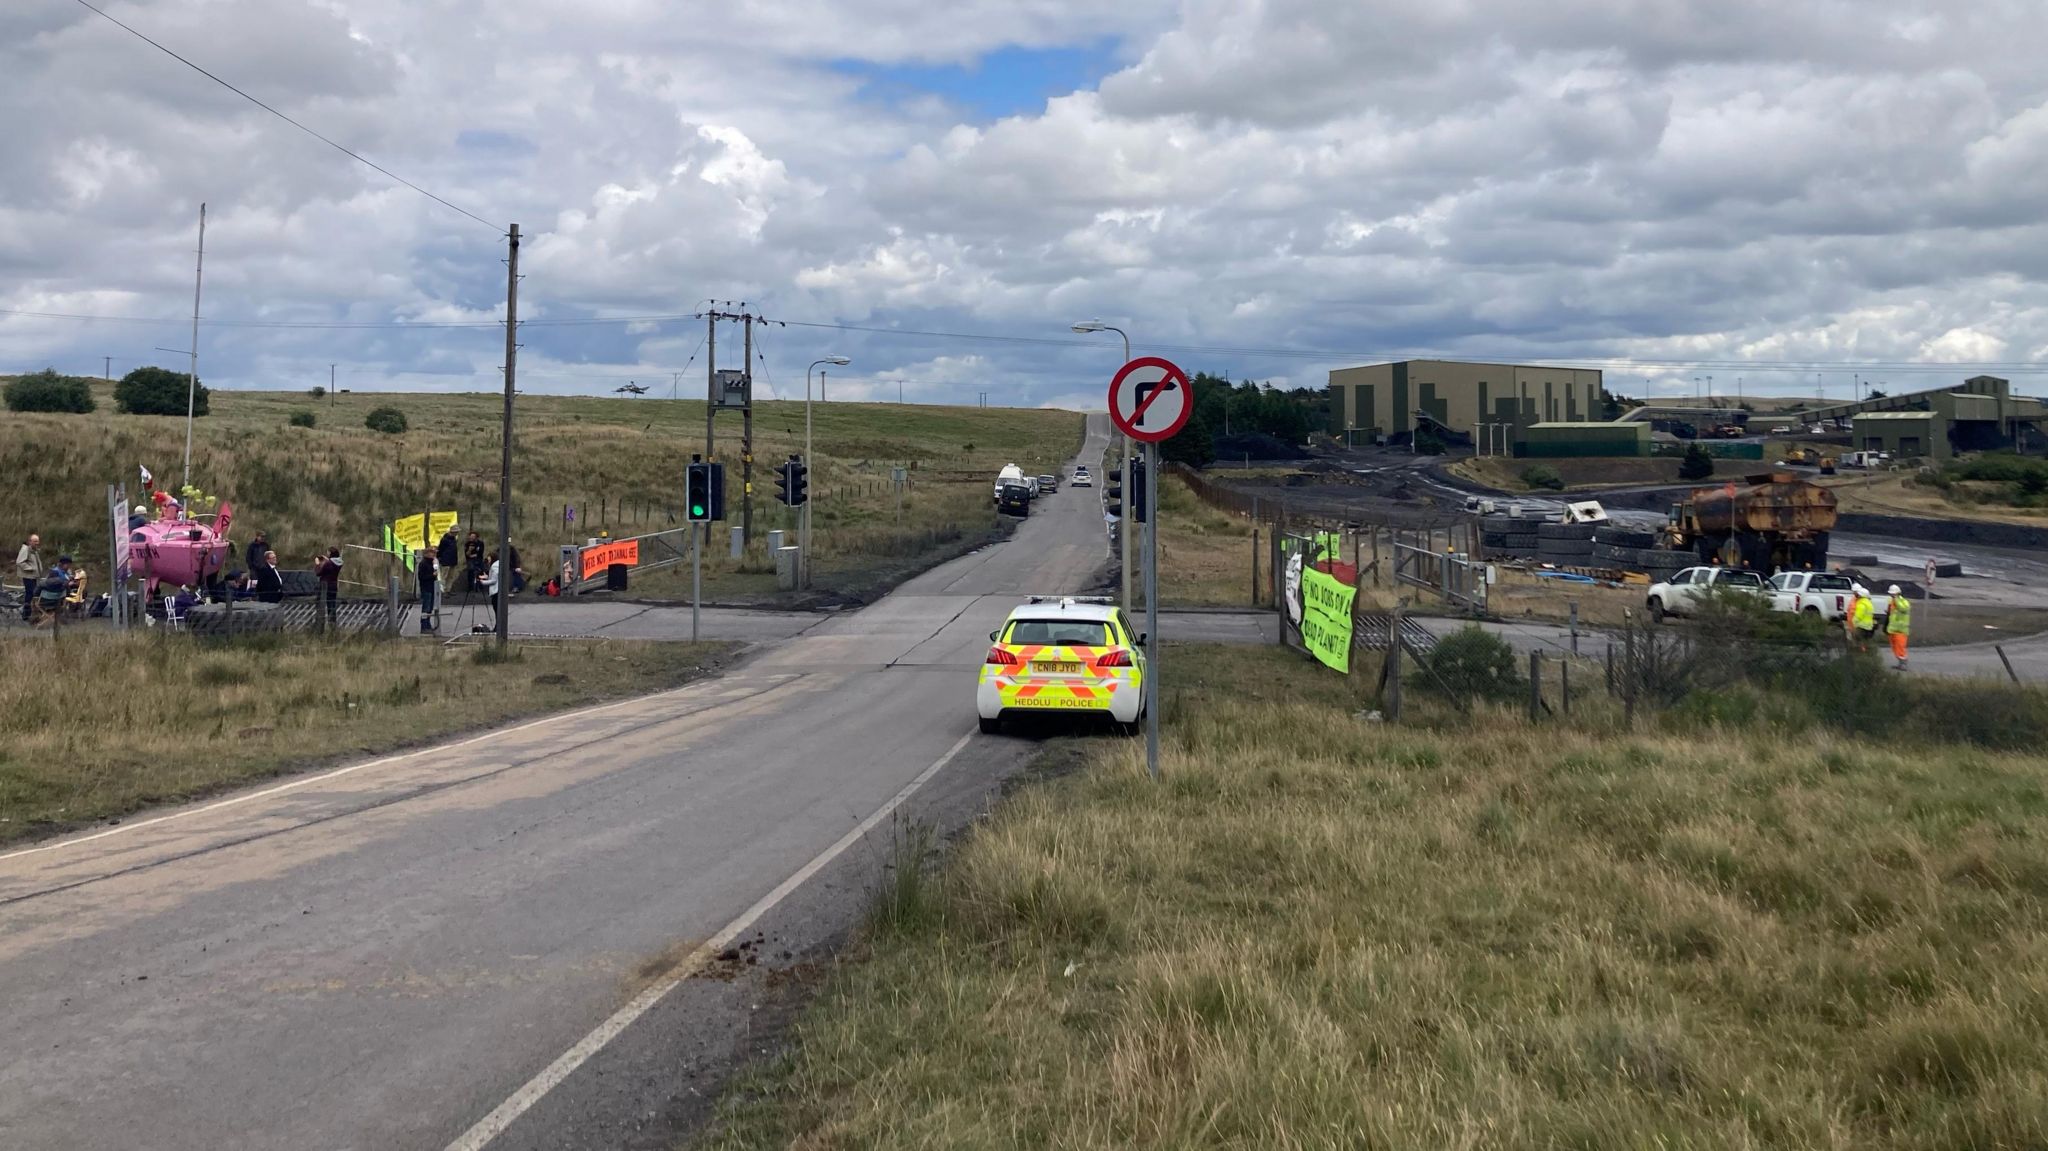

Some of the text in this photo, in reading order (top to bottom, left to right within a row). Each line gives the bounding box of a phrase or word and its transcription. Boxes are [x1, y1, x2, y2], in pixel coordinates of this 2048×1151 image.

[1310, 581, 1318, 601] NO
[1321, 585, 1334, 609] JOBS
[1037, 663, 1057, 672] CN18
[1014, 698, 1094, 708] HEDDLU POLICE
